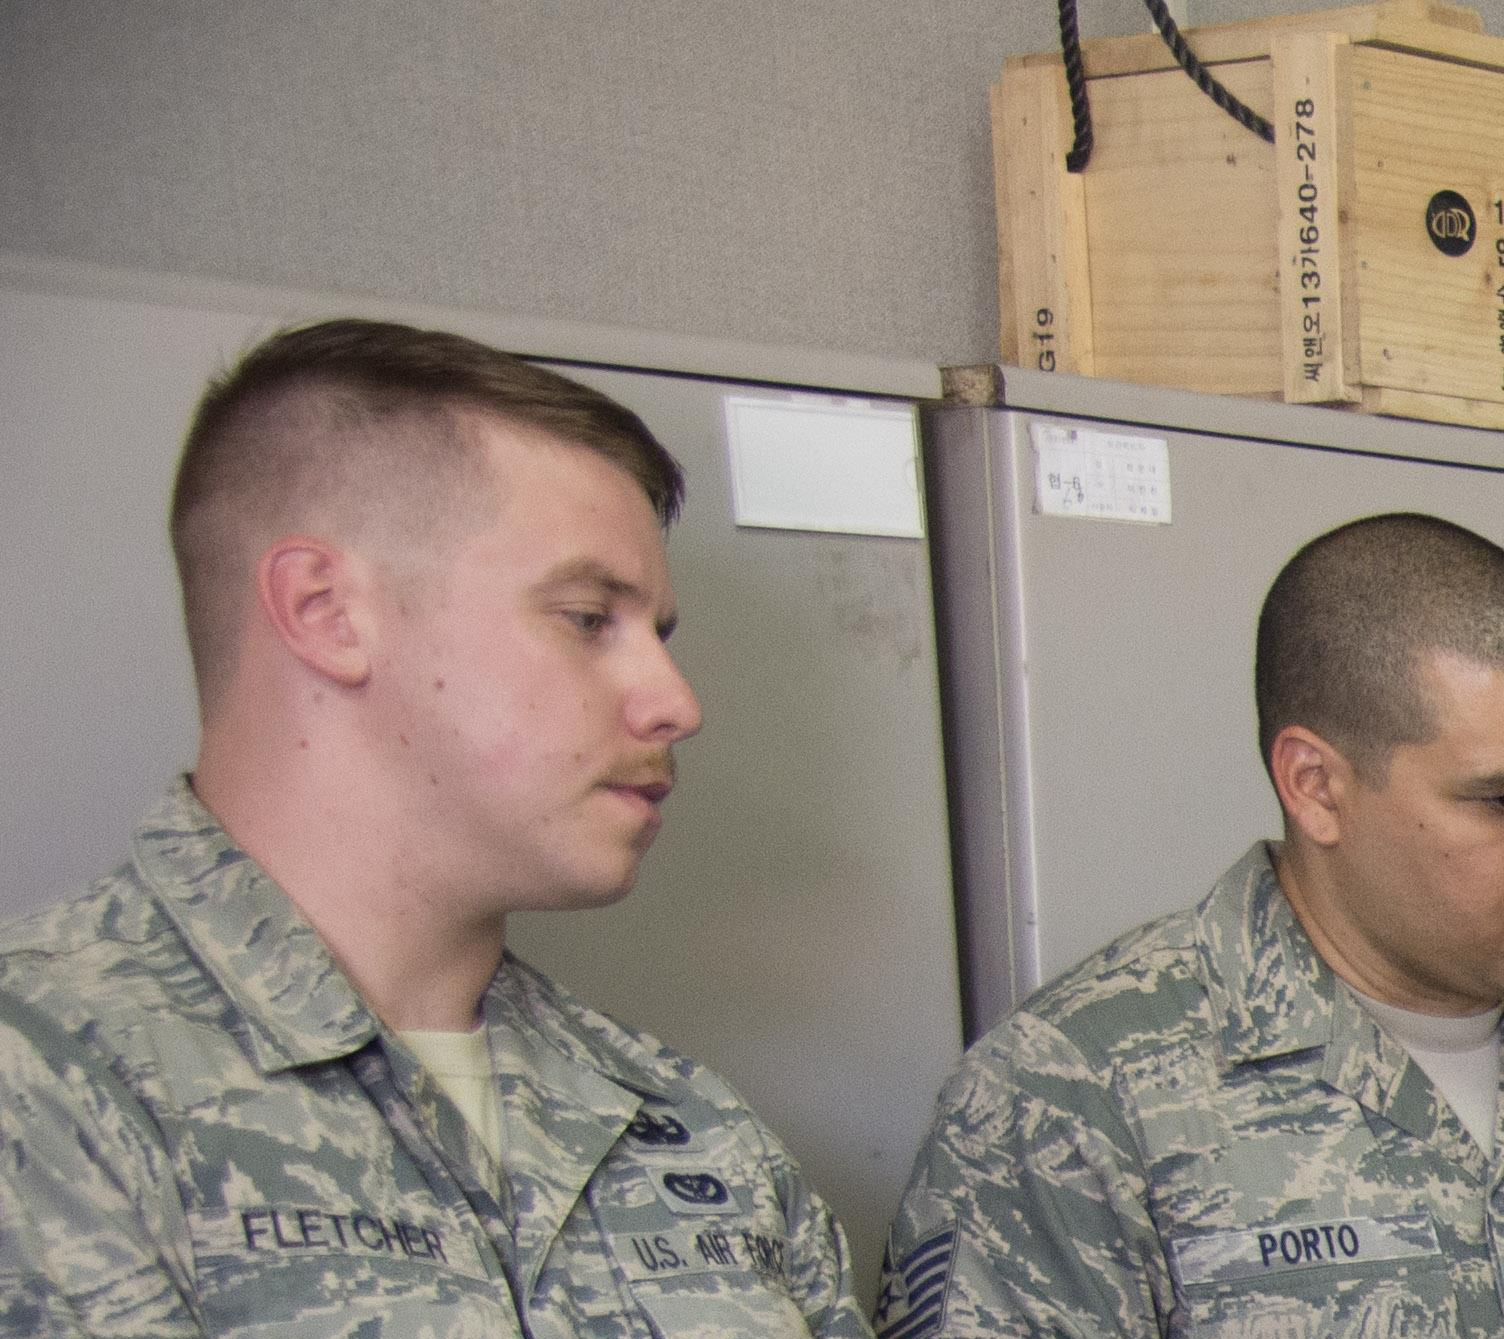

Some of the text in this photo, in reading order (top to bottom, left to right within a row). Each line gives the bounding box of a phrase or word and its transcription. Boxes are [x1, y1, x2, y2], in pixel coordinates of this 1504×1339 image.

[241, 1208, 449, 1264] FLETCHER
[631, 1235, 689, 1272] U.S.
[694, 1231, 739, 1266] AIR
[1257, 1224, 1360, 1268] PORTO
